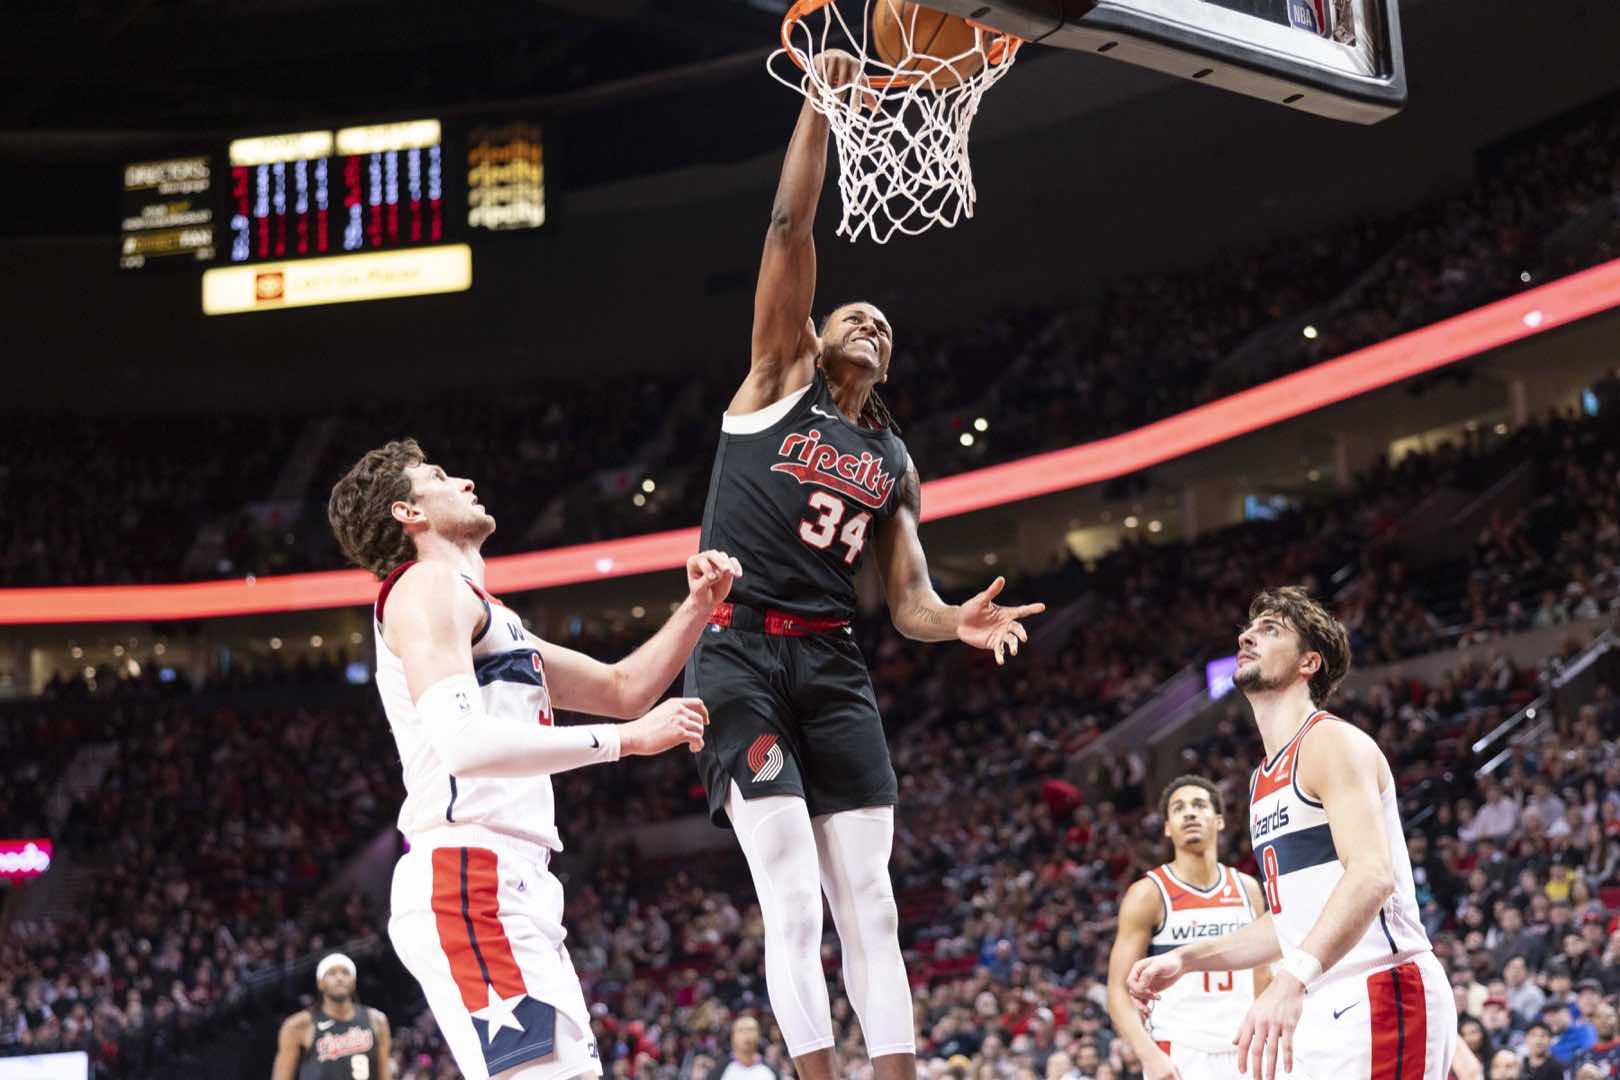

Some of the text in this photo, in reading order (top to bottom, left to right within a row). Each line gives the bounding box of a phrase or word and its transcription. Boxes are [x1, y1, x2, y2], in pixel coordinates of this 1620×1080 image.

[1293, 4, 1313, 27] NBA
[799, 490, 872, 566] 34
[1262, 845, 1282, 915] 8
